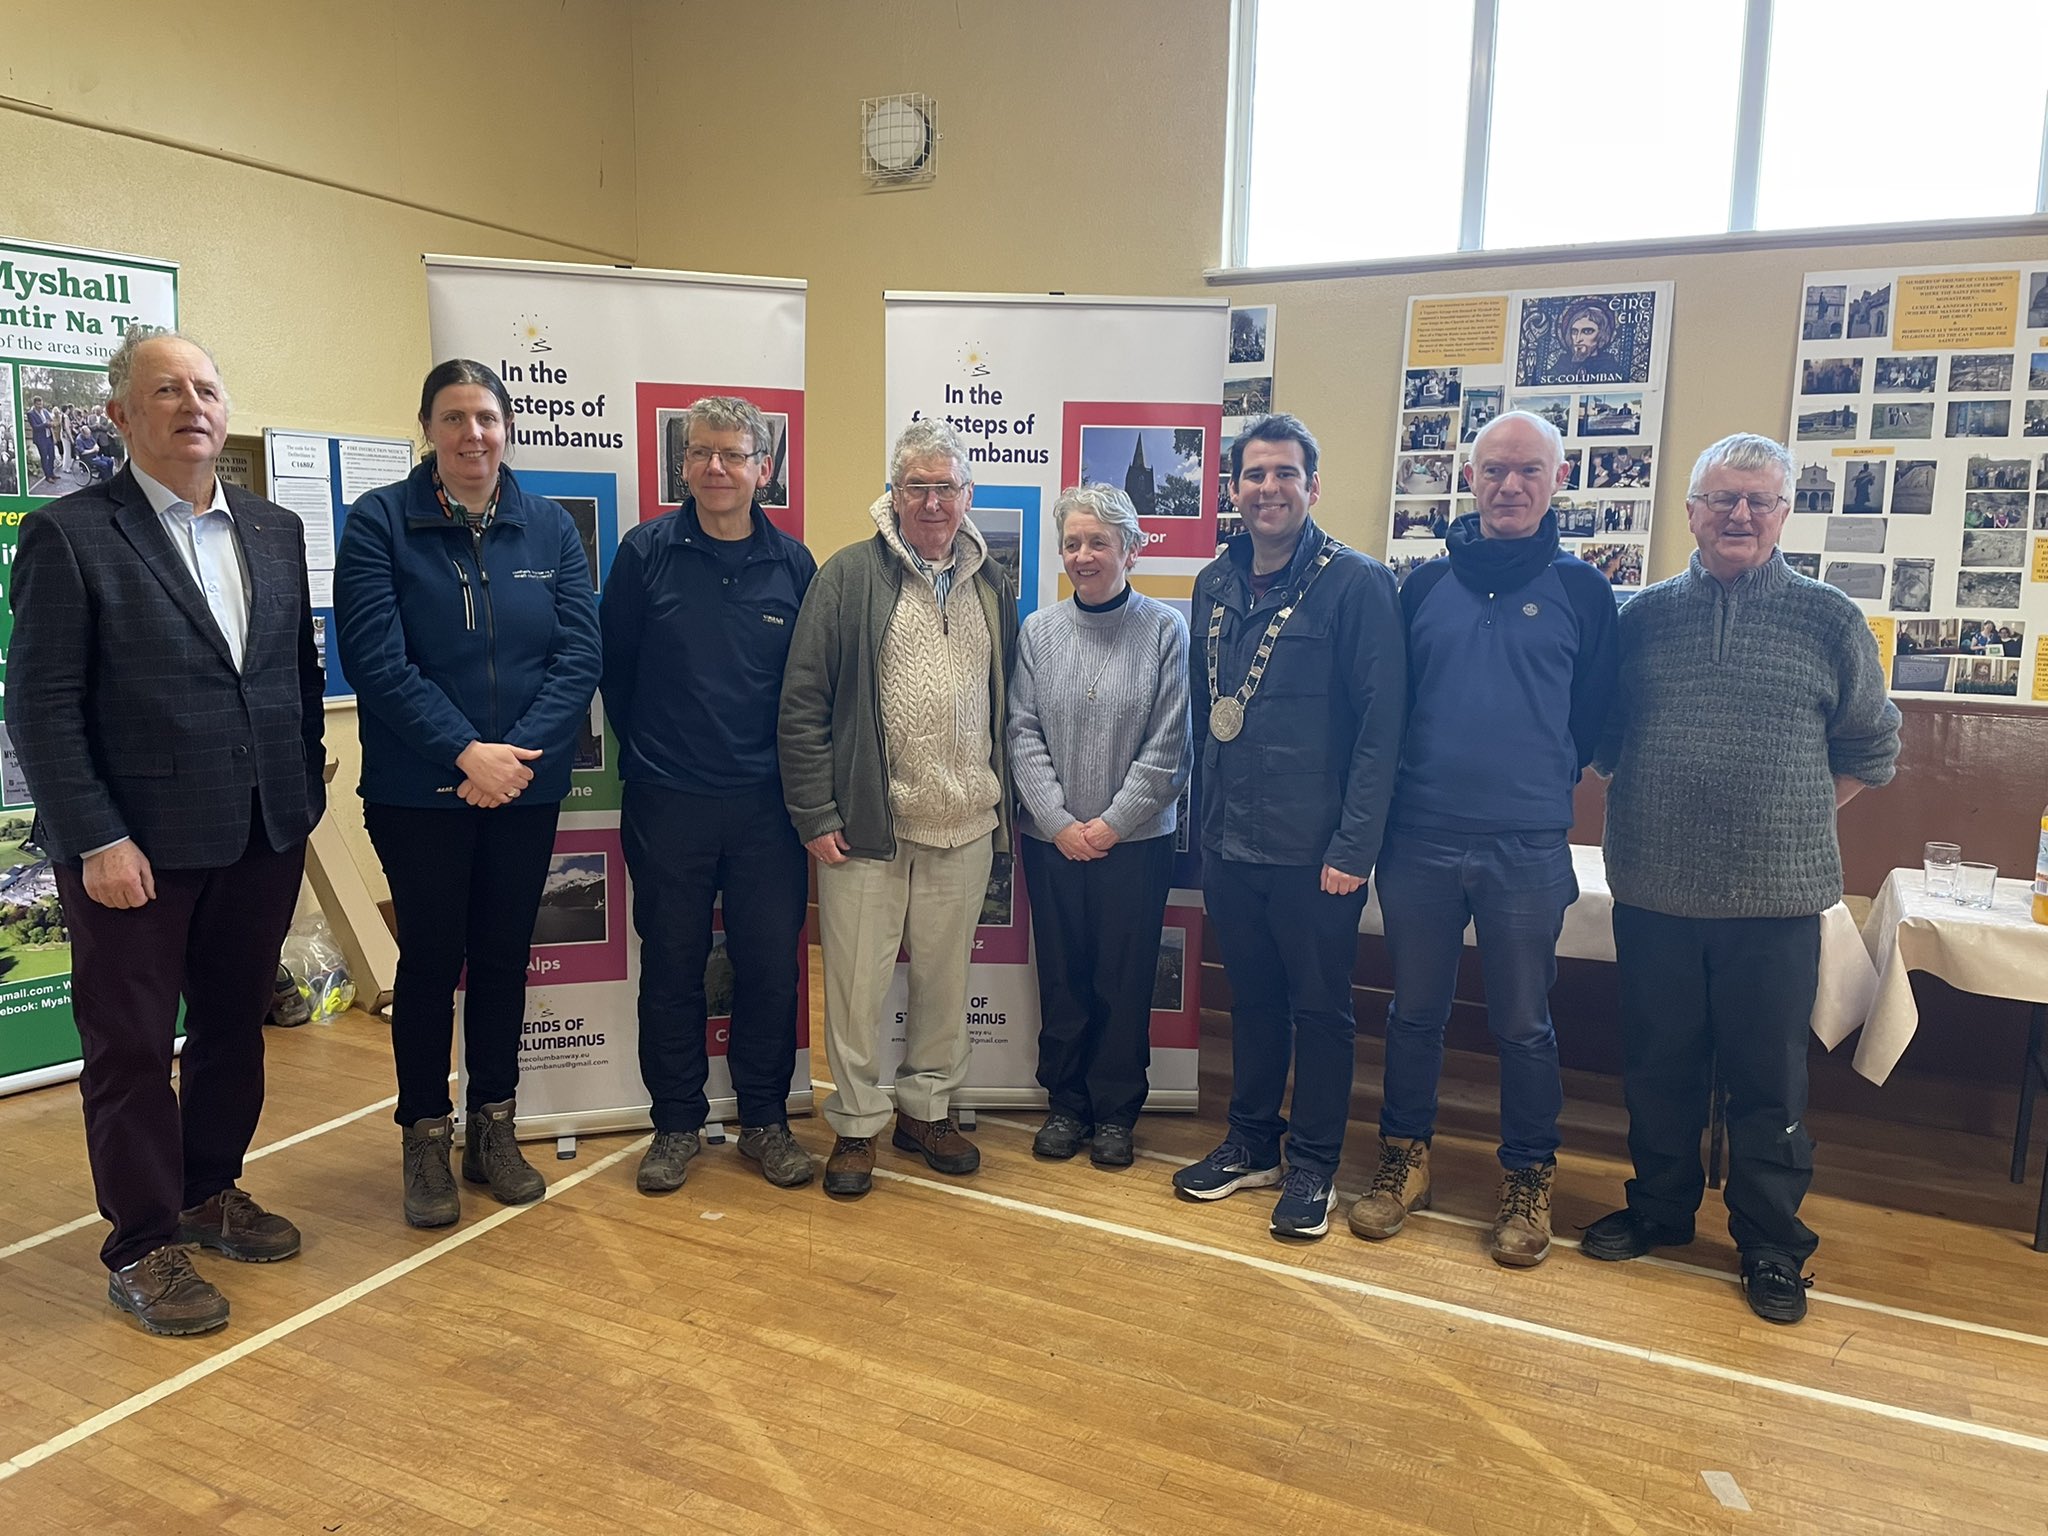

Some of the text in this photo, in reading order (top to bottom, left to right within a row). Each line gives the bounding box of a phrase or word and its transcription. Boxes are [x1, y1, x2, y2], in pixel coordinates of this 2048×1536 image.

[66, 310, 103, 335] Na
[18, 336, 43, 350] the
[48, 341, 80, 354] area
[501, 360, 567, 385] In the
[945, 383, 1003, 405] In the
[581, 394, 606, 417] of
[1013, 413, 1035, 434] of
[527, 956, 561, 975] Alps
[970, 997, 988, 1008] OF
[565, 1018, 585, 1031] OF
